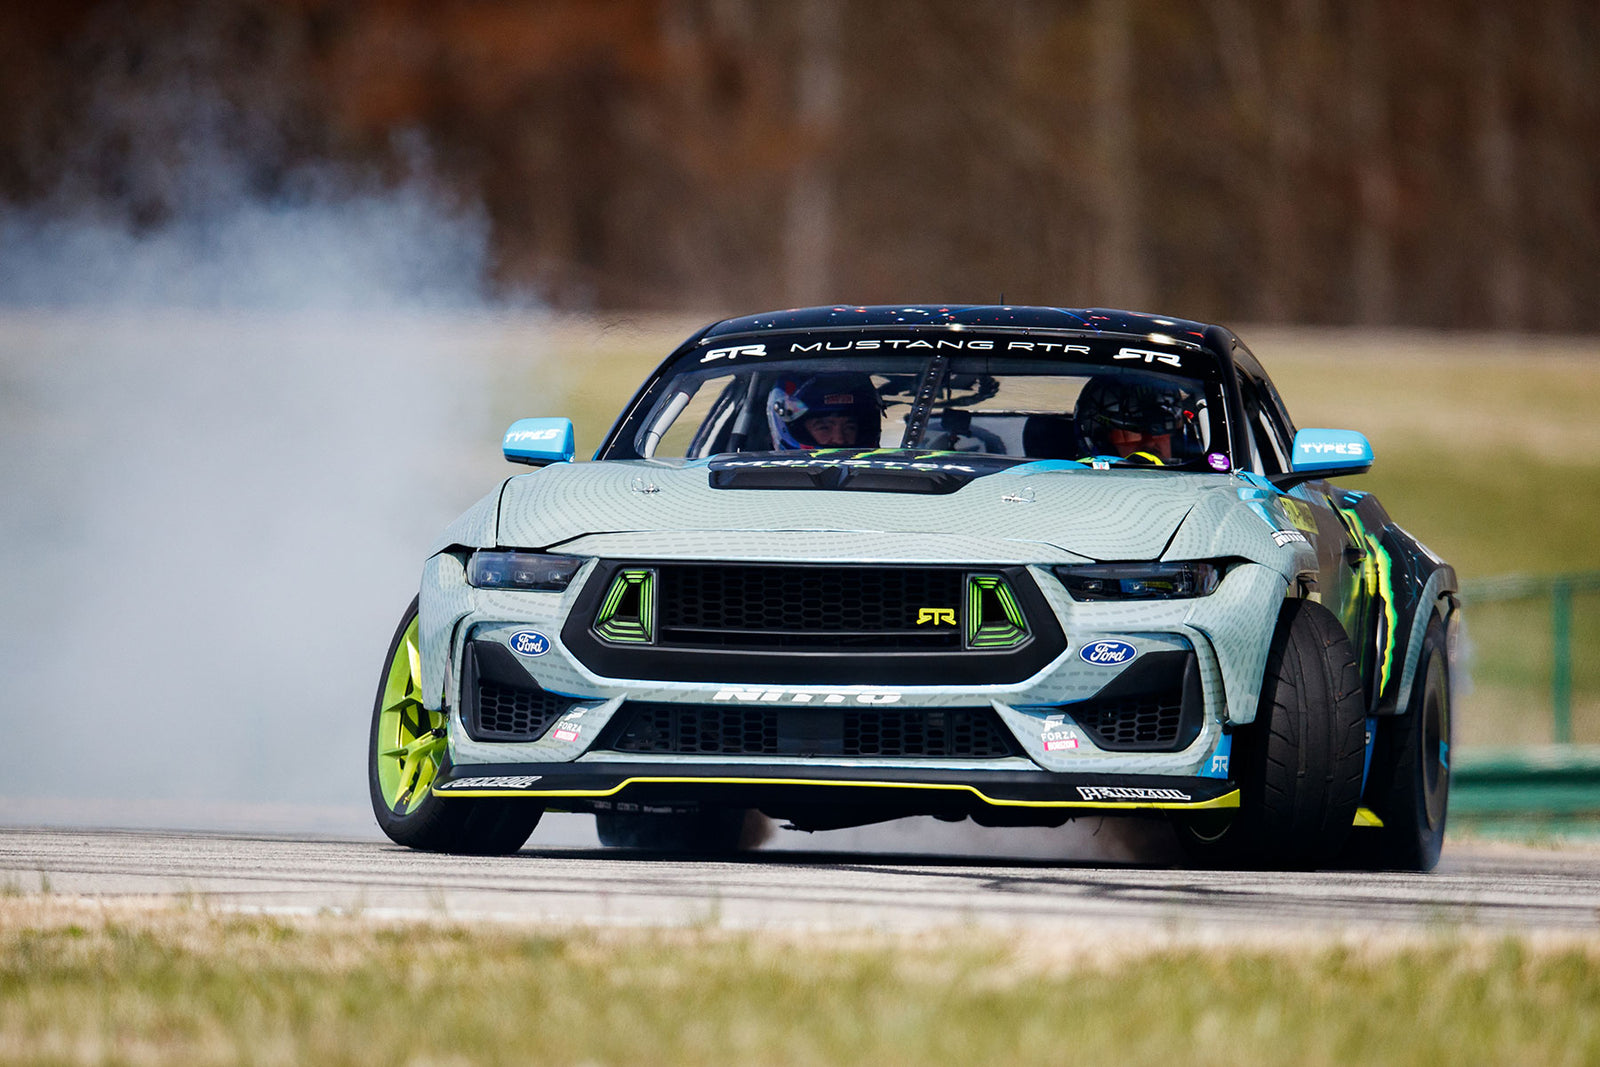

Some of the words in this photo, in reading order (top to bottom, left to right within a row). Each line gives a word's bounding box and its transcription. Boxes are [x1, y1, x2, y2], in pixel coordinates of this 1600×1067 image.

[700, 344, 767, 363] RTR
[790, 339, 995, 353] MUSTANG
[1007, 342, 1091, 355] RTR
[1112, 347, 1182, 368] RTR
[916, 607, 957, 626] RTR
[516, 633, 544, 654] Ford
[1089, 642, 1127, 662] Ford
[712, 687, 902, 704] NITTO
[557, 721, 583, 733] FORZA
[1040, 730, 1078, 742] FORZA
